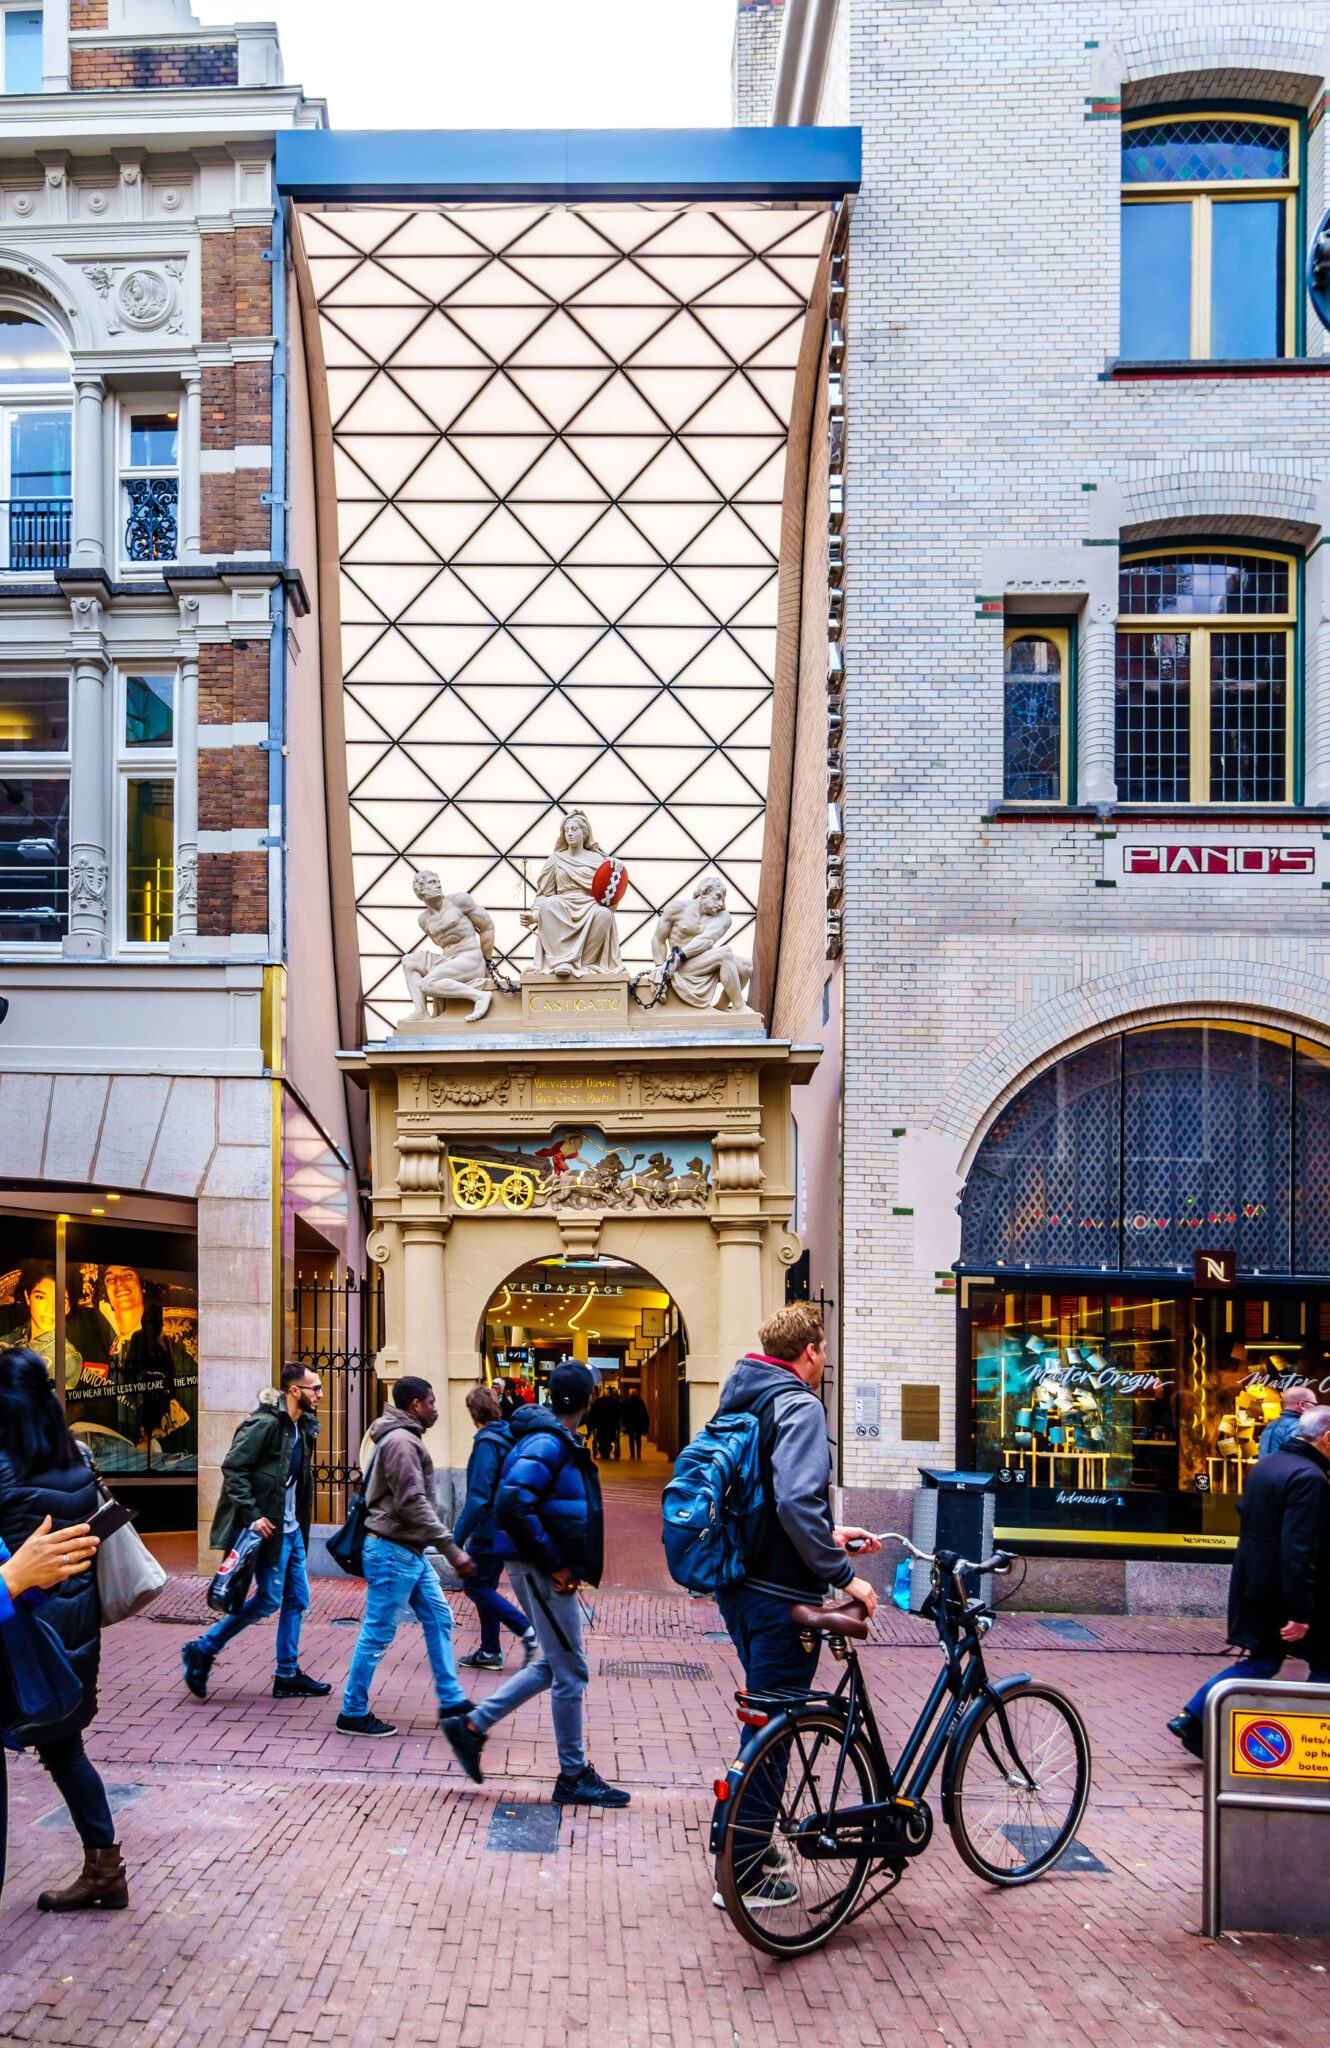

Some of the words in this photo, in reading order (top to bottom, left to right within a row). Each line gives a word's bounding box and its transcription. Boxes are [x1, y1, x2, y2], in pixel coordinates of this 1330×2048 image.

[1123, 846, 1315, 874] PIANO'S
[173, 1376, 186, 1387] THE
[1016, 1364, 1097, 1387] Master
[1096, 1366, 1176, 1394] Origin
[1236, 1371, 1319, 1393] Master
[68, 1389, 81, 1400] YOU
[82, 1387, 102, 1399] WEAR
[103, 1384, 116, 1396] THE
[117, 1382, 133, 1394] LESS
[133, 1380, 147, 1392] YOU
[147, 1378, 164, 1391] CARE
[1055, 1490, 1115, 1504] Indonesia
[1304, 1750, 1318, 1759] op
[1298, 1761, 1329, 1772] boten
